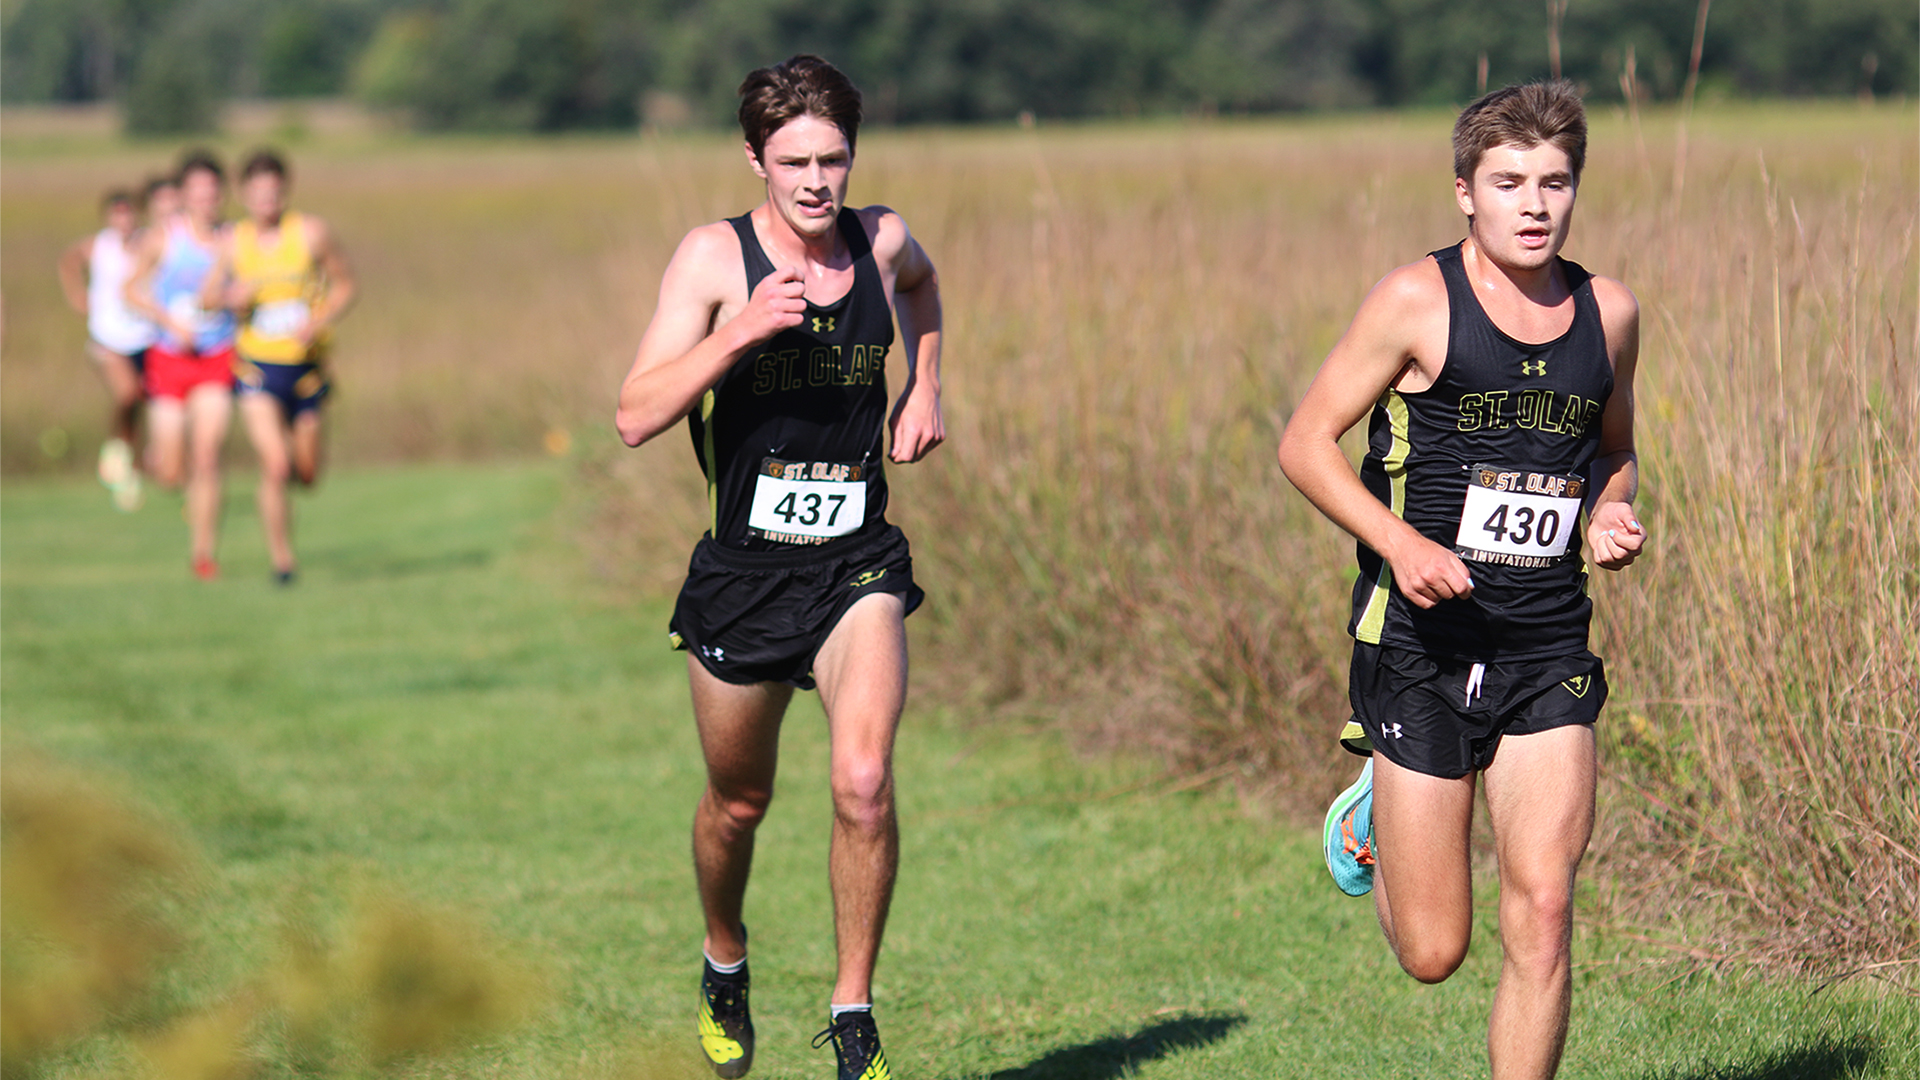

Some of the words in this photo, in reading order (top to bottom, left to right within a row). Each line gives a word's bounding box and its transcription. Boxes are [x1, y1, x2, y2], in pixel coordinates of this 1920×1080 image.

[752, 349, 802, 395] ST.
[808, 344, 884, 387] OLAF
[1457, 390, 1509, 432] ST.
[1516, 389, 1600, 439] OLAF
[783, 462, 808, 481] ST.
[811, 461, 850, 482] OLAF
[1495, 472, 1522, 491] ST.
[1526, 472, 1566, 497] OLAF
[773, 492, 847, 527] 437
[763, 530, 837, 546] INVITATIO
[1483, 504, 1560, 547] 430
[1472, 549, 1551, 568] INVITATIONAL
